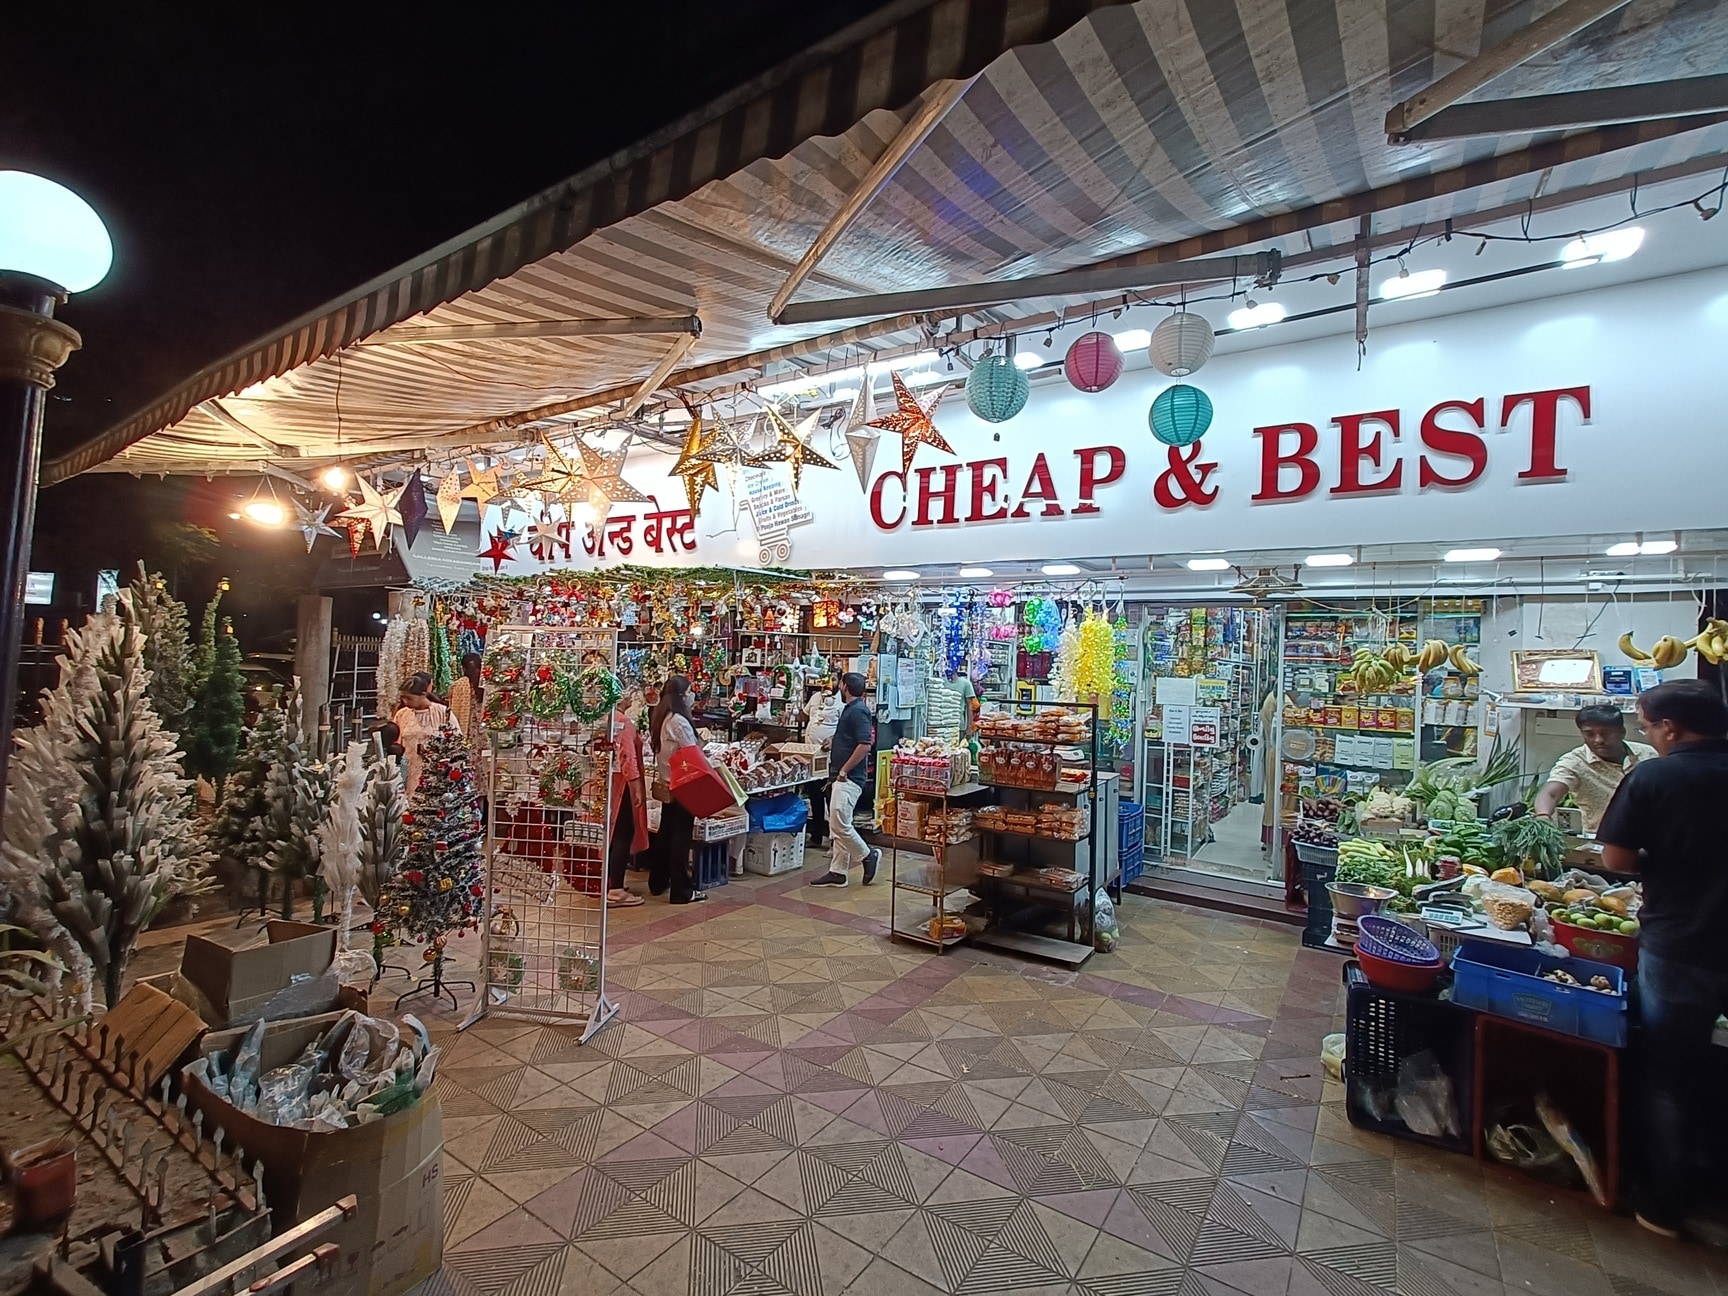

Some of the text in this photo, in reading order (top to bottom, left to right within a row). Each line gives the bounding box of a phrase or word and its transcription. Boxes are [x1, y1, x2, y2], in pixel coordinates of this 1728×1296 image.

[870, 385, 1590, 530] CHEAP & BEST
[773, 503, 784, 511] Cold
[777, 507, 802, 517] Vegetables
[422, 1163, 438, 1188] HS
